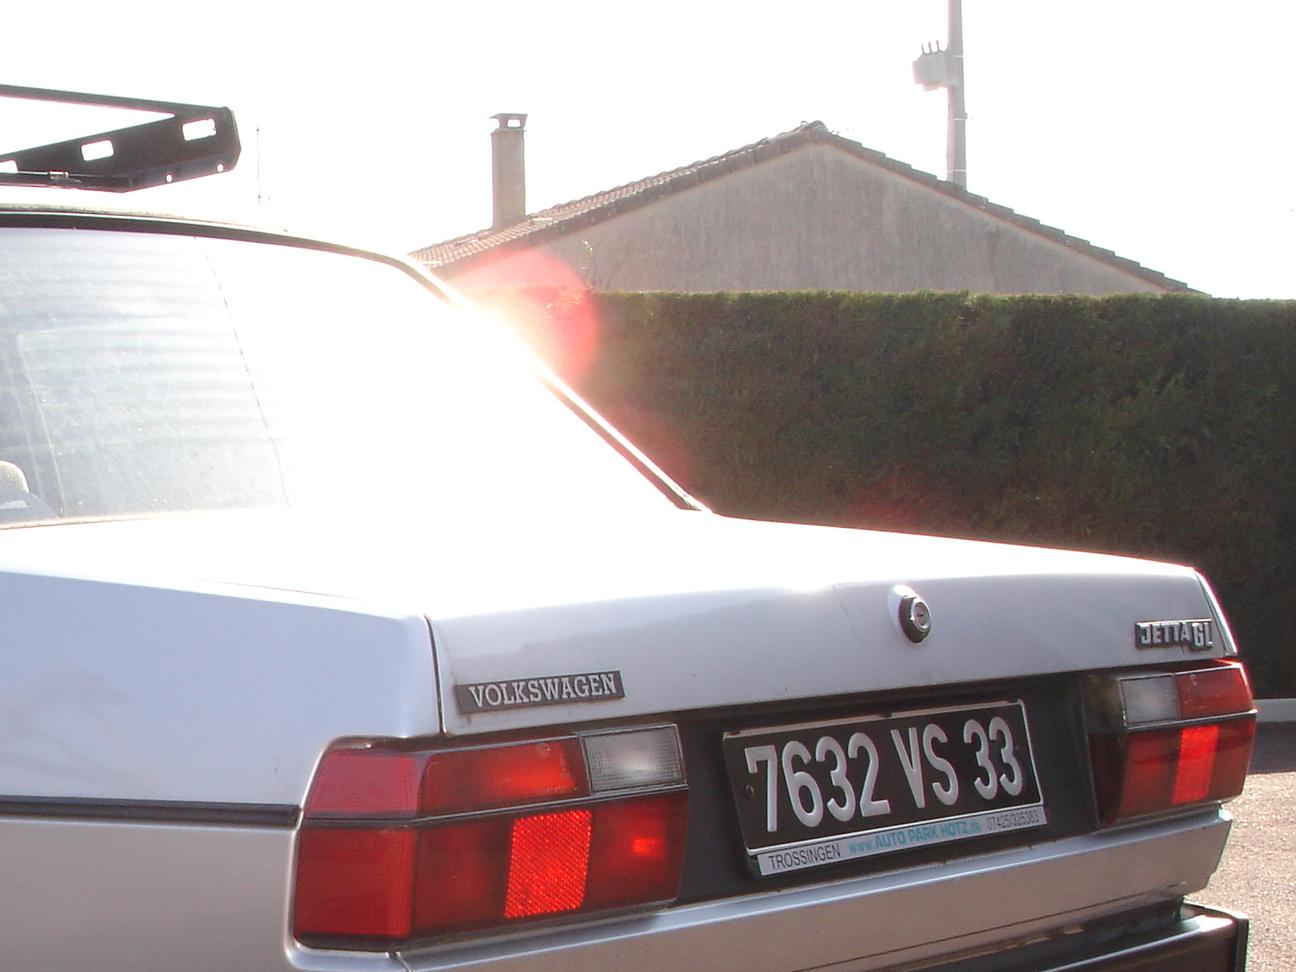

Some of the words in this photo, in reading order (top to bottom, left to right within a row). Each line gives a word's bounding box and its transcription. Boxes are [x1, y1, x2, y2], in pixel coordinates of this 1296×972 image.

[1139, 621, 1190, 645] JETTA
[469, 673, 617, 708] VOLKSWAGEN
[745, 732, 891, 832] 7632
[891, 723, 959, 808] VS
[963, 716, 1023, 800] 33
[768, 844, 841, 870] TROSSINGEN
[909, 823, 939, 843] PARK
